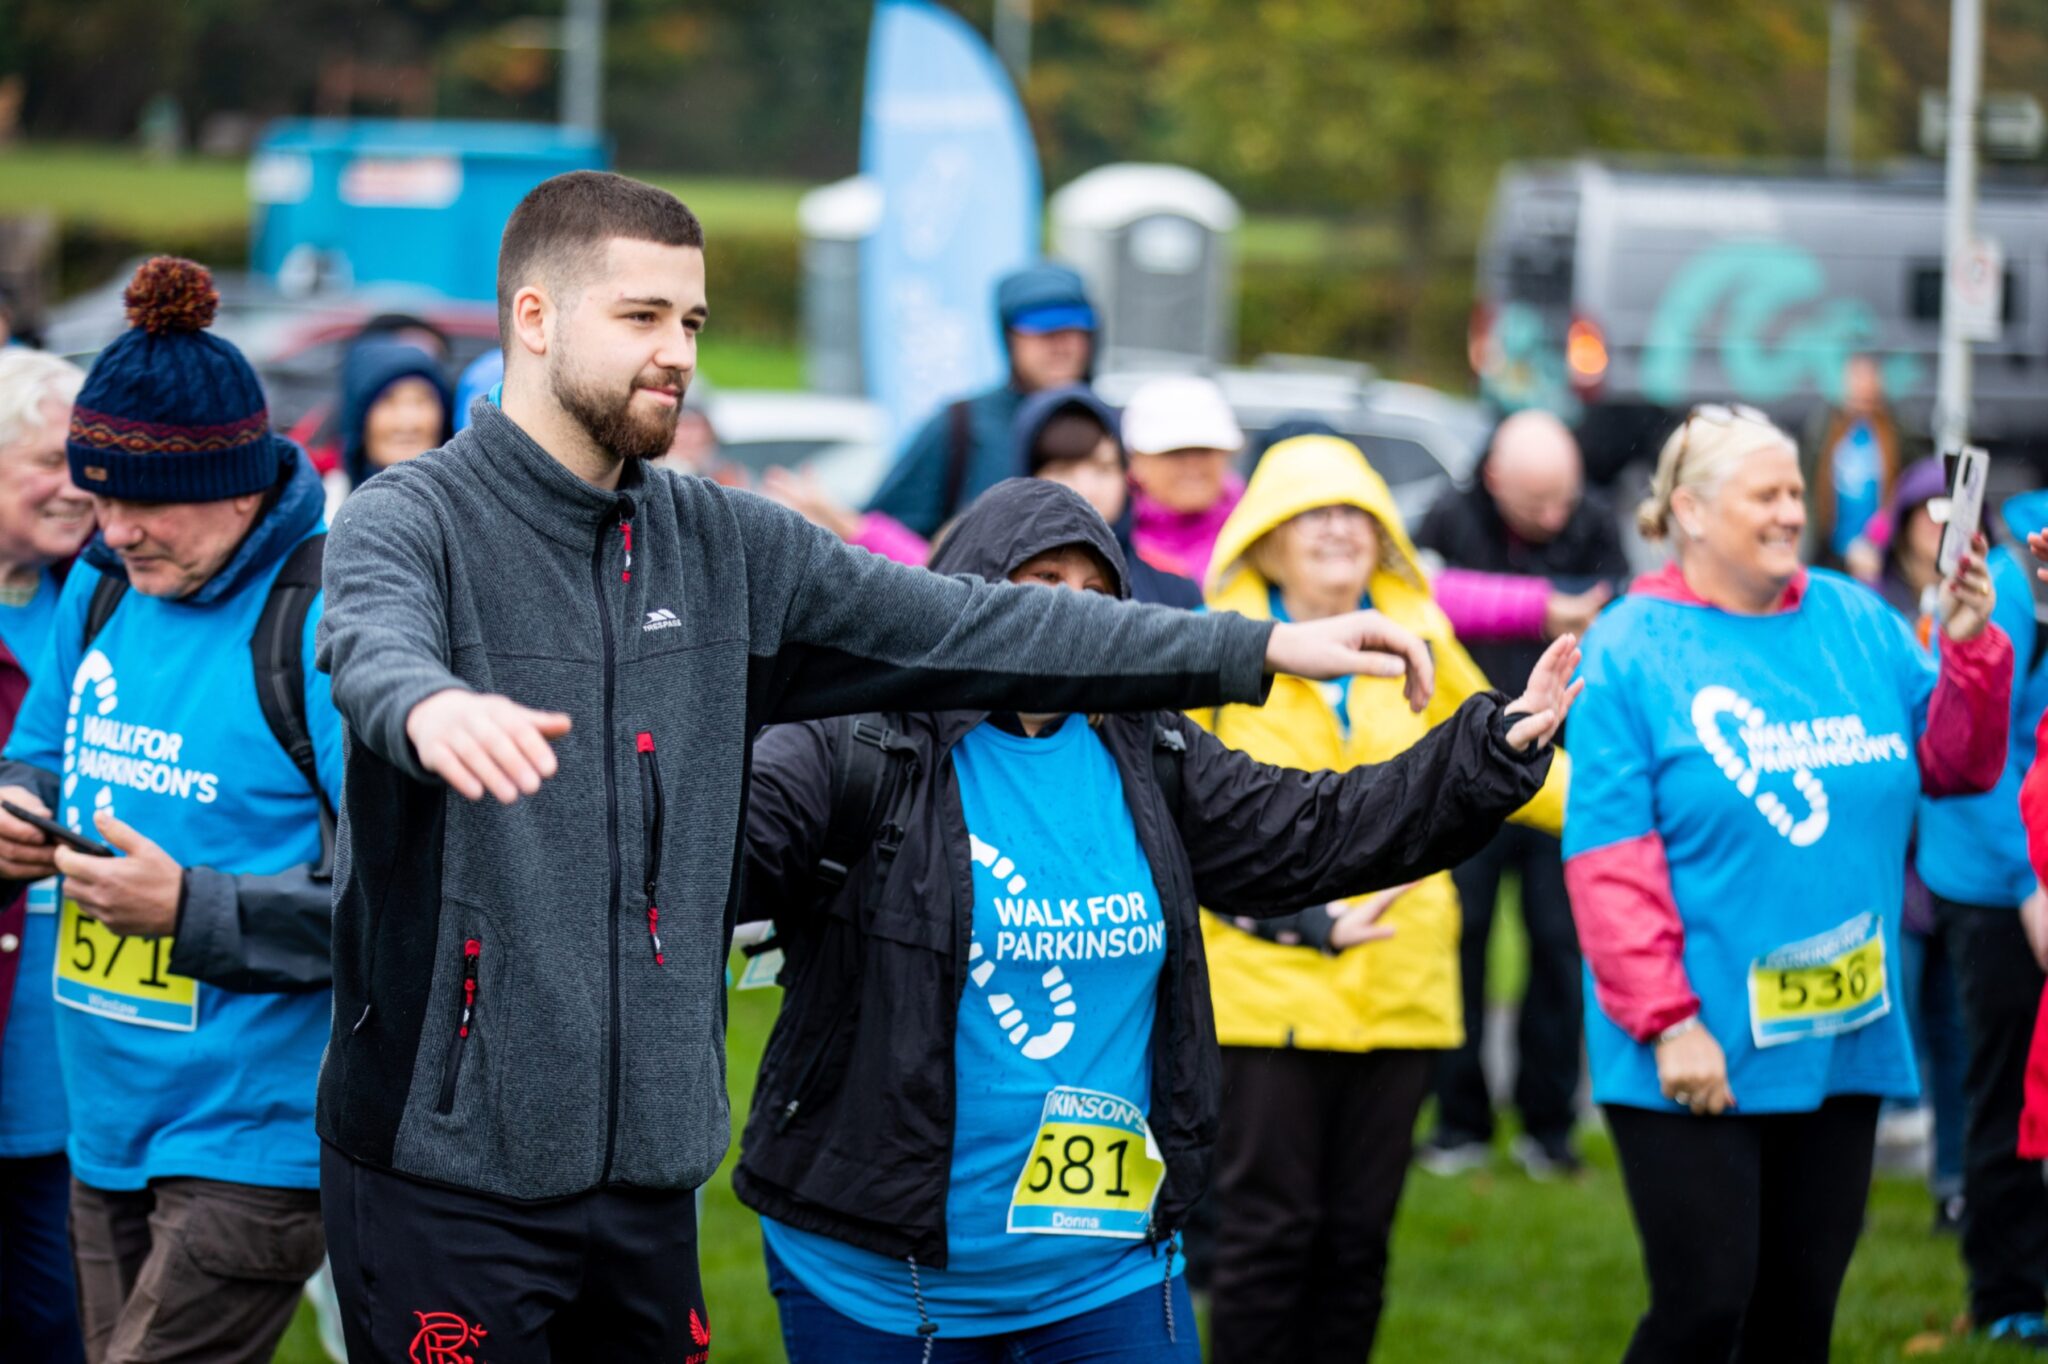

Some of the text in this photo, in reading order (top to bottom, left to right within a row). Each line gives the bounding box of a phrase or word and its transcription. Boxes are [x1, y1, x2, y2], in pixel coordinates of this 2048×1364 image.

[83, 714, 183, 763] WALK FOR
[1738, 714, 1866, 753] WALK FOR
[993, 891, 1148, 927] WALK FOR
[72, 914, 168, 988] 571
[996, 919, 1166, 961] PARKINSON'
[1779, 951, 1867, 1010] 536
[1050, 1094, 1146, 1133] KINSON'S
[1028, 1134, 1130, 1197] 581
[1052, 1212, 1099, 1229] Donna
